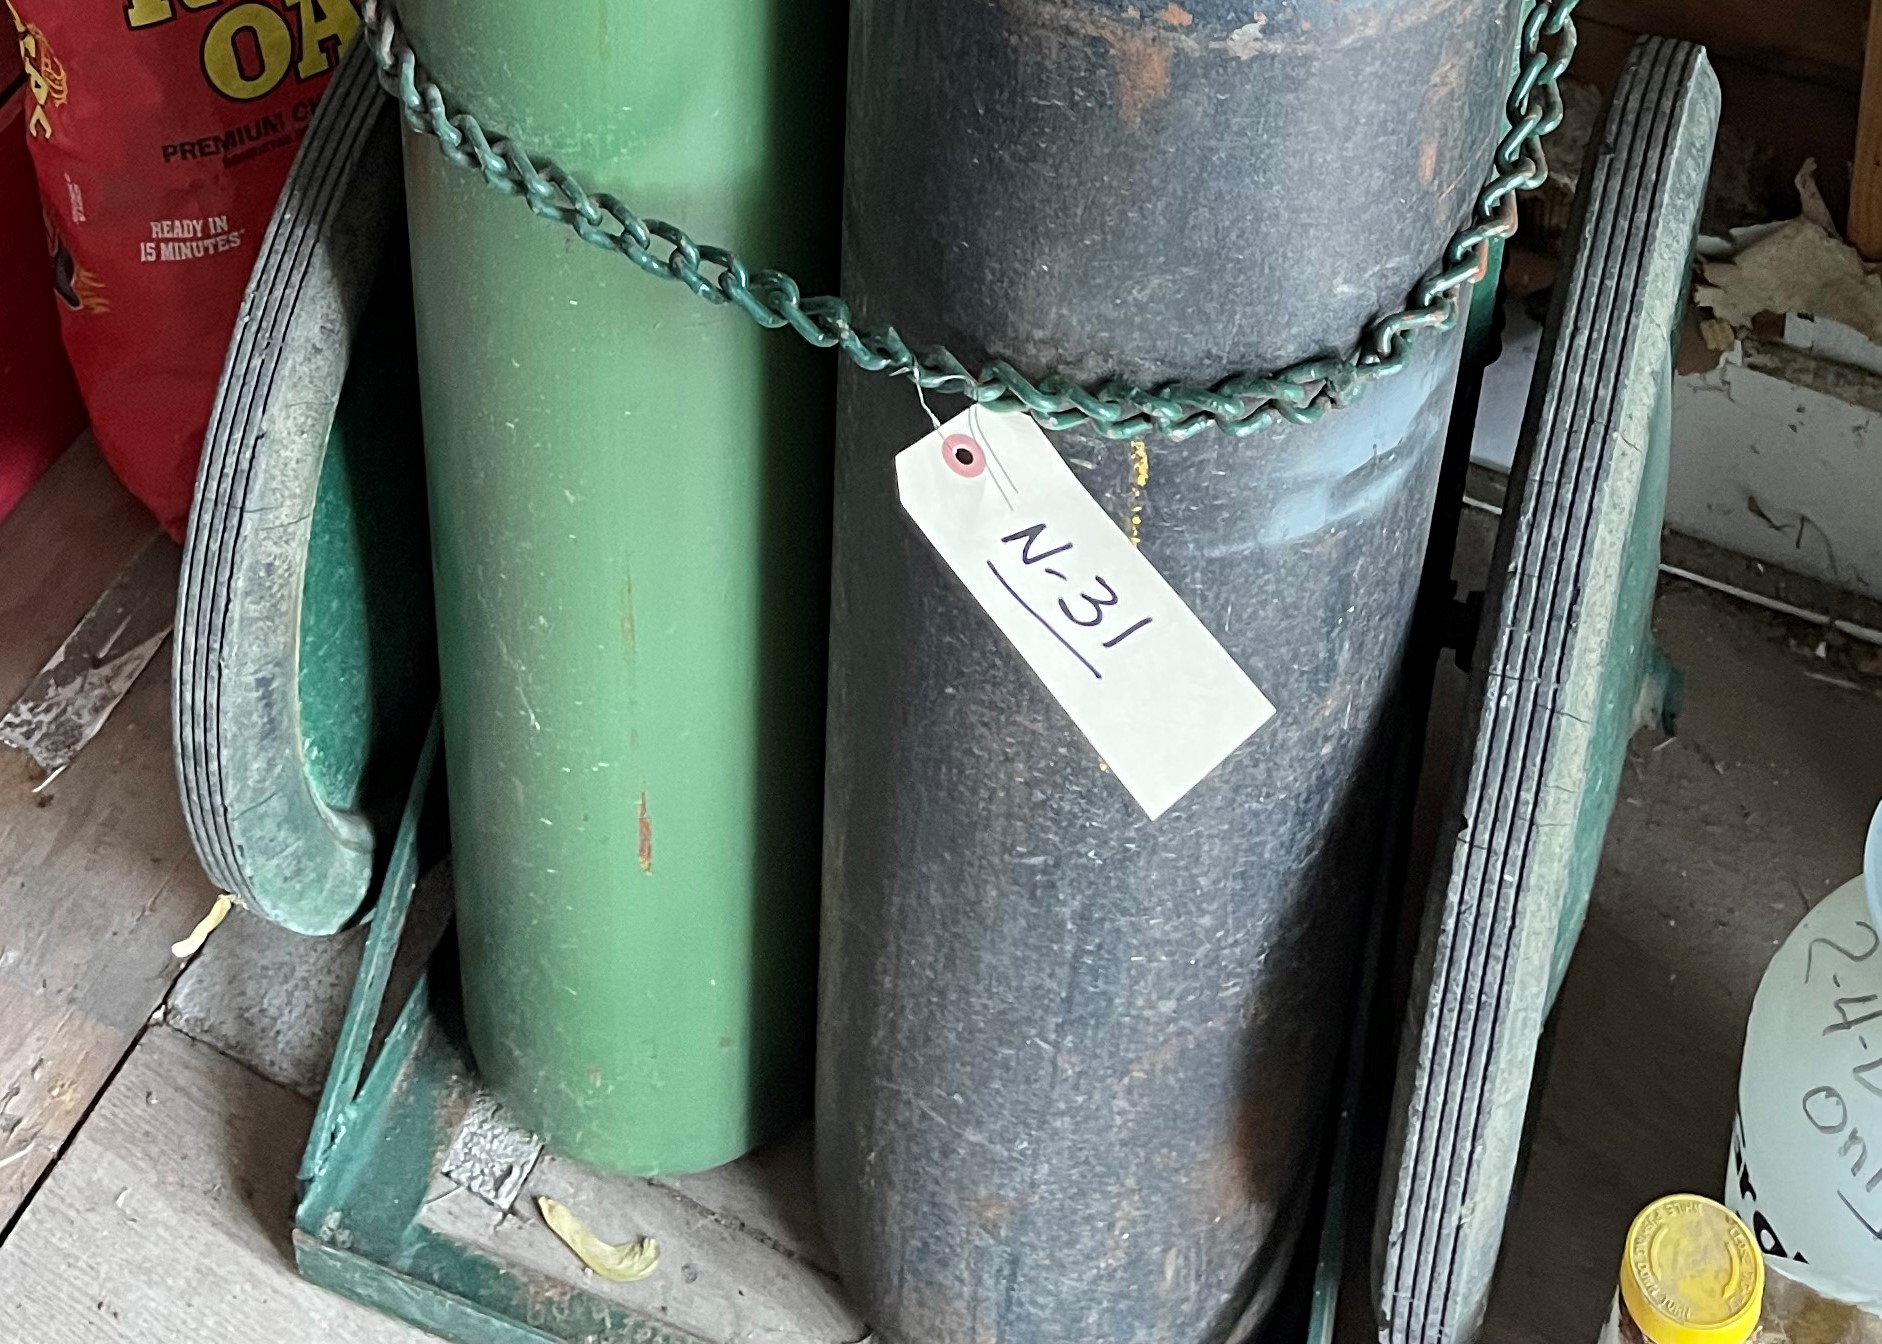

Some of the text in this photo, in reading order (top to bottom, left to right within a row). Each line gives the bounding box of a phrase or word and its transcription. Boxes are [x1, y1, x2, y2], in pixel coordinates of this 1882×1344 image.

[162, 112, 287, 162] PREMIUM
[150, 216, 228, 238] READY IN
[140, 243, 156, 262] 15
[1001, 523, 1154, 649] N-31
